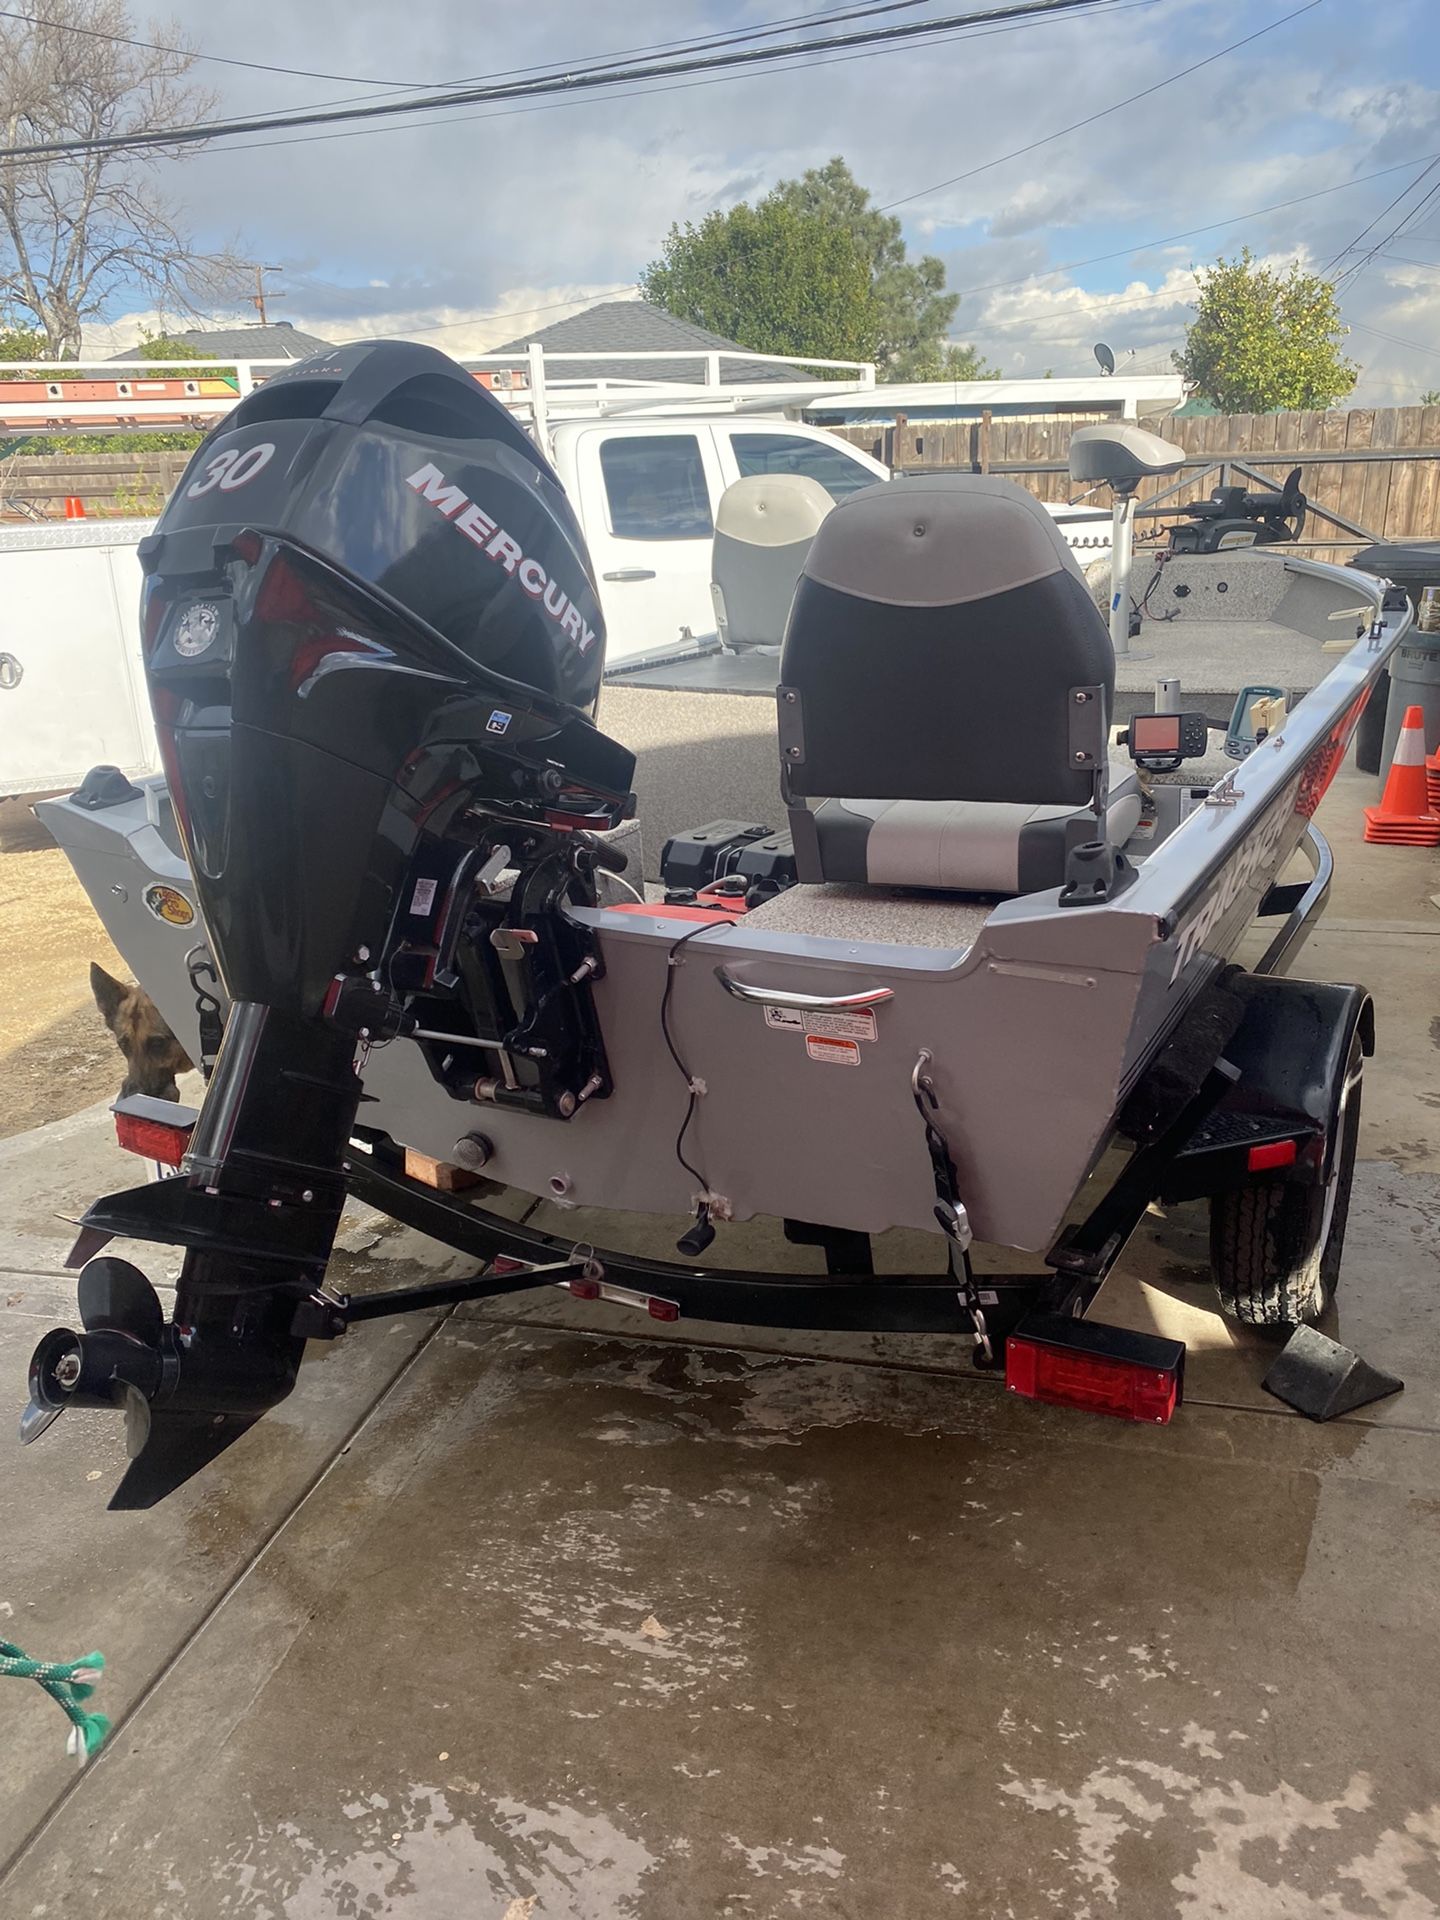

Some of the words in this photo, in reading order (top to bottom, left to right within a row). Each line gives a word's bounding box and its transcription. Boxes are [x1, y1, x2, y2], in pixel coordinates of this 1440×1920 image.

[187, 443, 276, 500] 30
[406, 462, 596, 657] MERCURY
[1401, 648, 1437, 662] BRUTE
